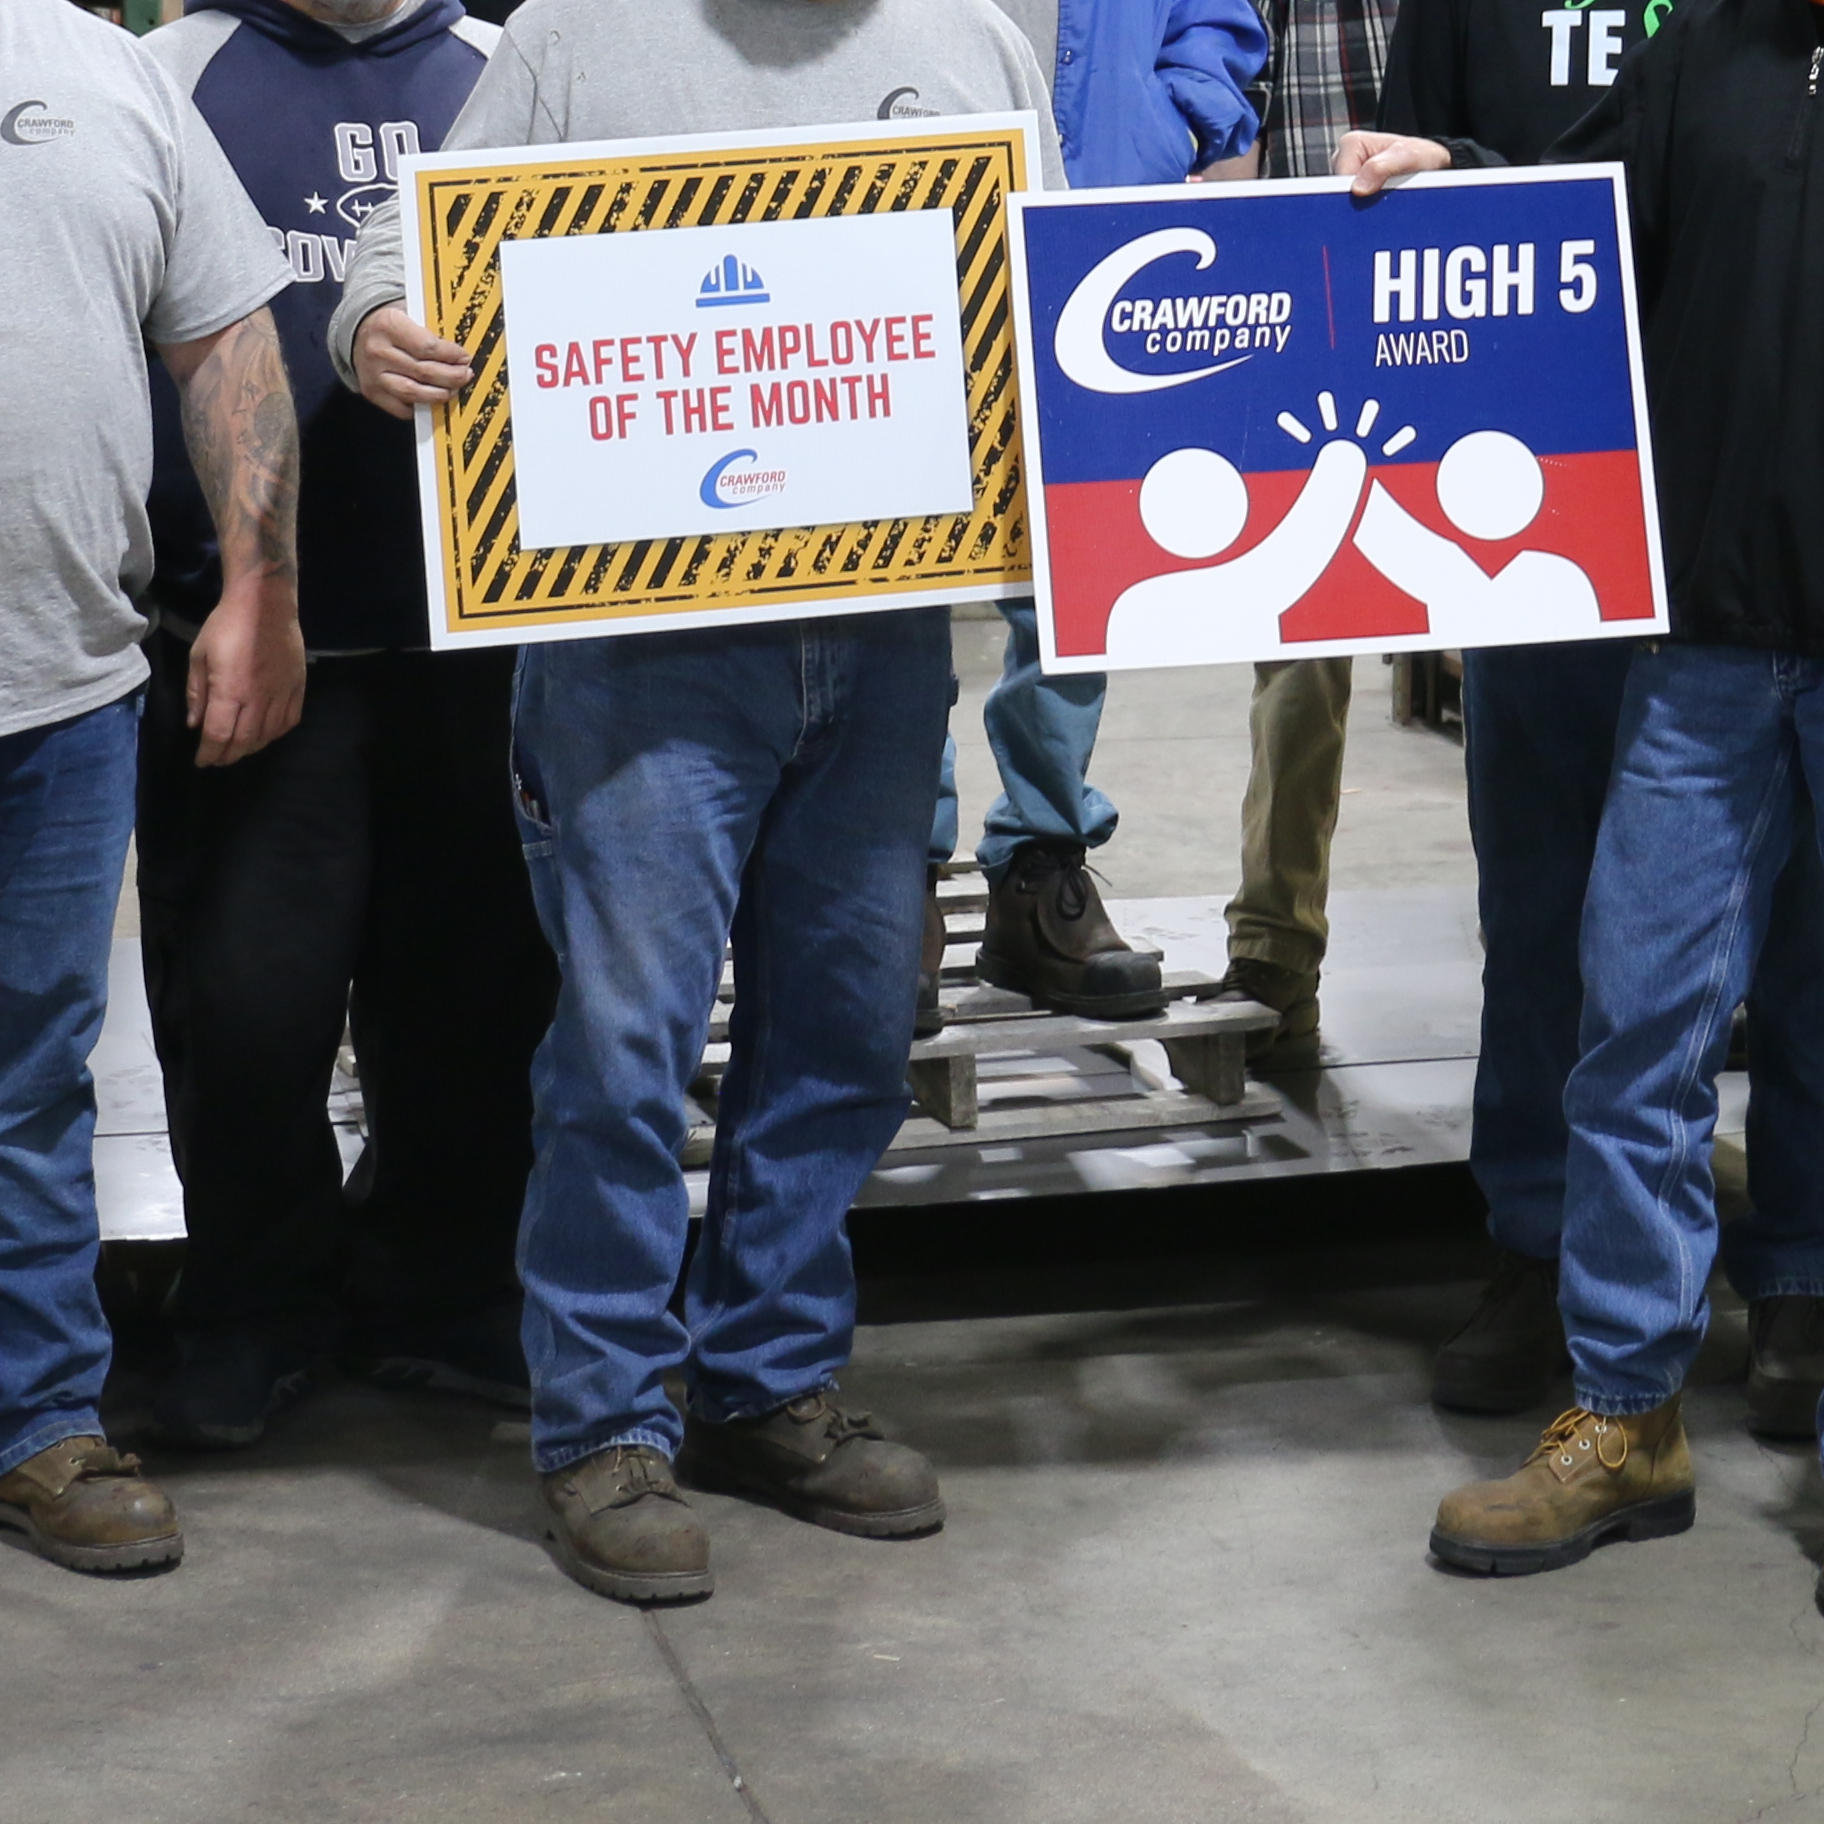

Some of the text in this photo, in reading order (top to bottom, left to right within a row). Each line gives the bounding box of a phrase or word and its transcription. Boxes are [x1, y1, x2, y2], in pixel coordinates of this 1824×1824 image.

[17, 118, 74, 129] CRAWFORD
[29, 128, 75, 136] company
[334, 121, 421, 183] GO
[1372, 238, 1599, 326] HIGH 5
[1110, 291, 1293, 333] CRAWFORD
[533, 312, 938, 391] SAFETY EMPLOYEE
[1145, 323, 1292, 358] company
[1374, 327, 1470, 369] AWARD
[588, 371, 893, 443] OF THE MONTH
[719, 470, 788, 489] CRAWFORD
[732, 479, 787, 497] company
